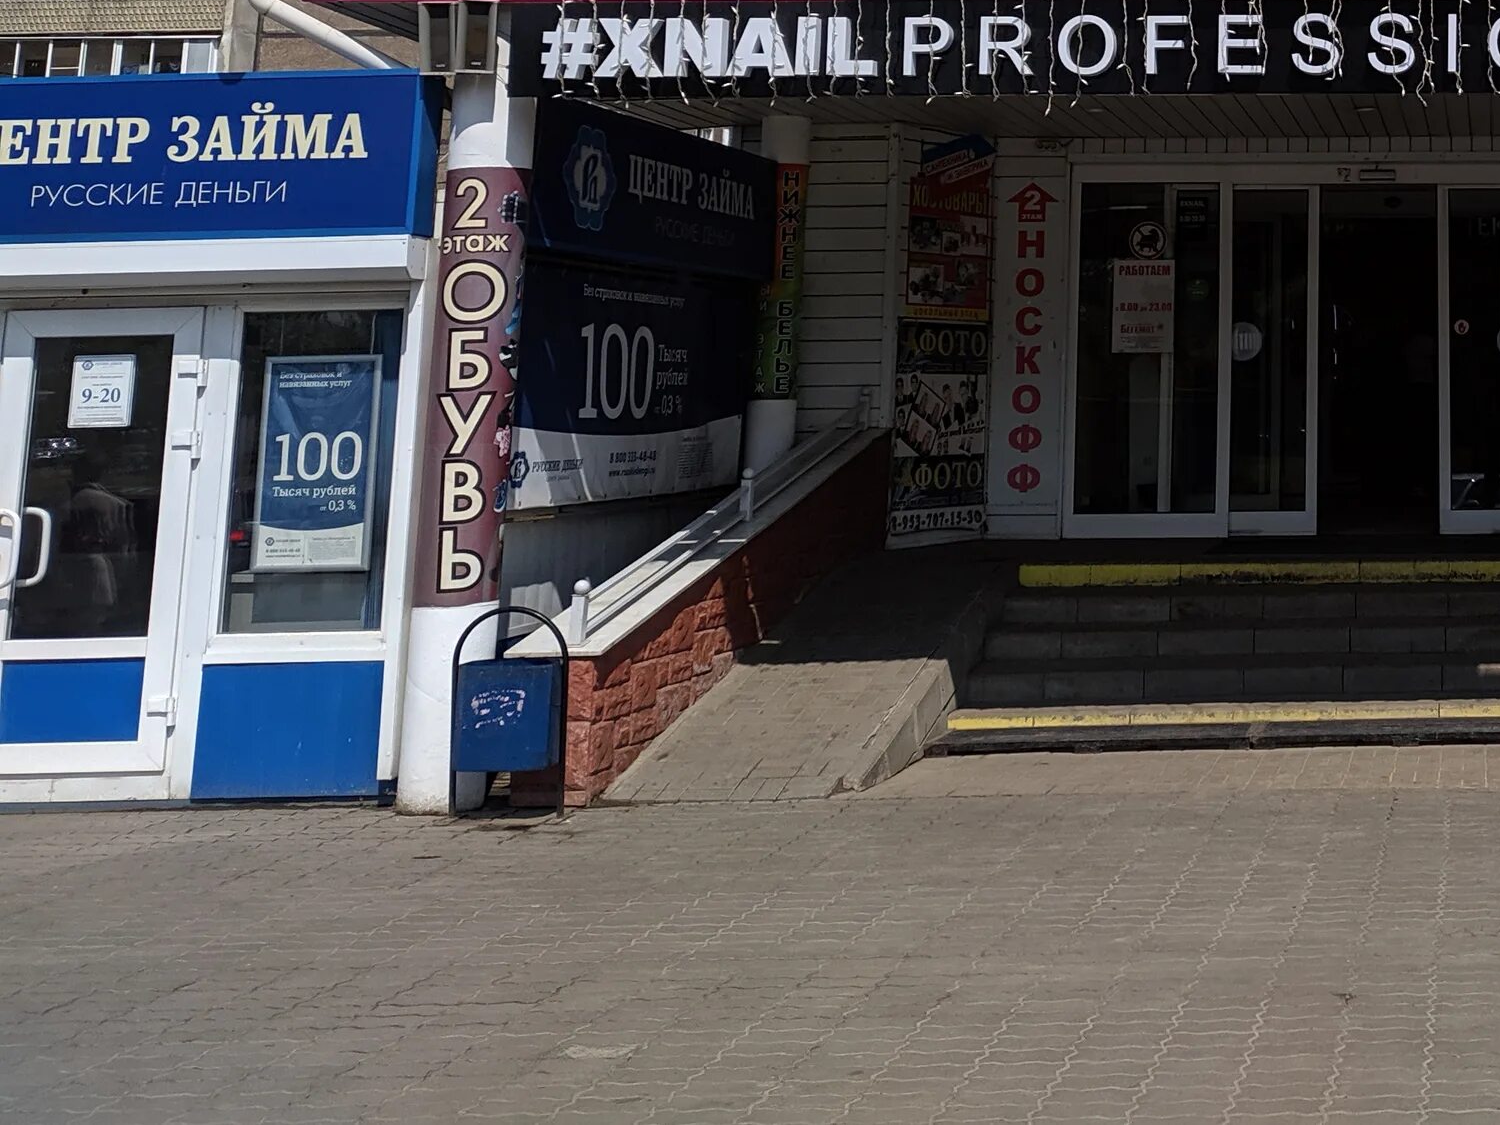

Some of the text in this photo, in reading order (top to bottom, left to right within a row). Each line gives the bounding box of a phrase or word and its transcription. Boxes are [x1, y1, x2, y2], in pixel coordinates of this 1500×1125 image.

[541, 15, 878, 81] #XNAIL
[166, 101, 369, 163] ЗАЙМА
[30, 180, 287, 208] РУССКИЕ ДЕНЬГИ
[628, 154, 756, 221] ЦЕНТР ЗАЙМА
[1023, 190, 1042, 211] 2
[450, 177, 489, 230] 2
[440, 231, 512, 254] этаж
[1119, 265, 1171, 276] РАБОТАЕМ
[658, 344, 688, 363] Тысяч
[919, 328, 987, 357] ФОТО
[578, 322, 655, 420] 100
[1007, 230, 1046, 492] НОСКОФФ
[81, 387, 121, 404] 9-20
[437, 258, 509, 594] ОБУВЬ
[273, 430, 363, 482] 100
[915, 461, 982, 490] ФОТО
[272, 484, 356, 499] Тысяч рублей
[328, 500, 344, 513] 0,3
[347, 500, 356, 511] %
